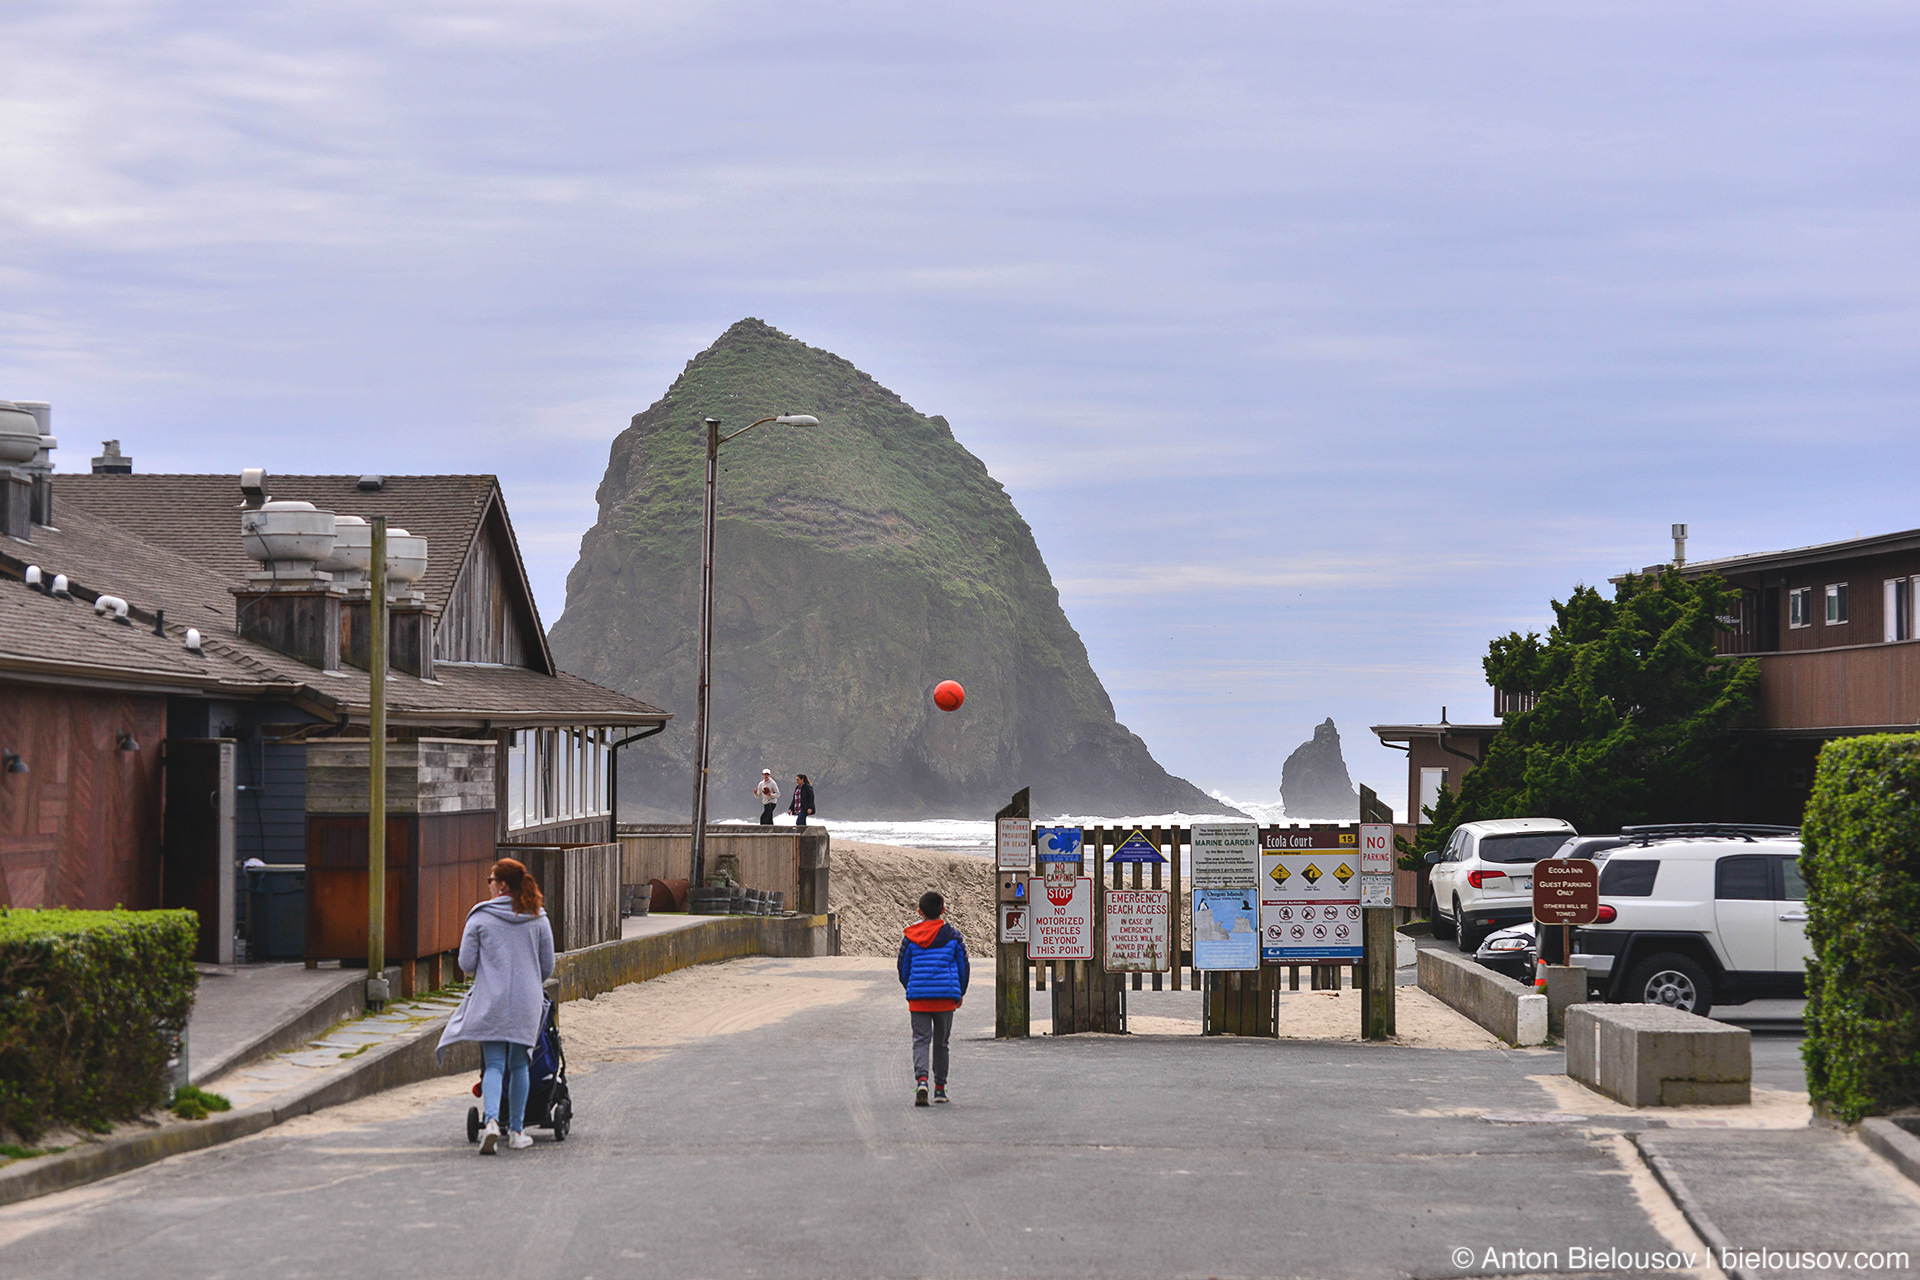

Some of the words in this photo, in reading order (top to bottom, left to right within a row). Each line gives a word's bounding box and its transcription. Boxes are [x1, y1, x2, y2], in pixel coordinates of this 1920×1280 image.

[1266, 835, 1287, 847] Ecola
[1289, 835, 1313, 847] Court
[1367, 836, 1386, 849] NO
[1363, 853, 1390, 861] PARKING
[1055, 862, 1065, 870] NO
[1046, 873, 1073, 882] CAMPING
[1048, 888, 1072, 899] STOP
[1112, 894, 1162, 903] EMERGENCY
[1054, 907, 1066, 915] NO
[1107, 905, 1133, 914] BEACH
[1136, 905, 1167, 914] ACCESS
[1036, 917, 1084, 925] MOTORIZED
[1040, 926, 1081, 935] VEHICLES
[1043, 936, 1077, 944] BEYOND
[1036, 946, 1055, 954] THIS
[1059, 946, 1084, 954] POINT
